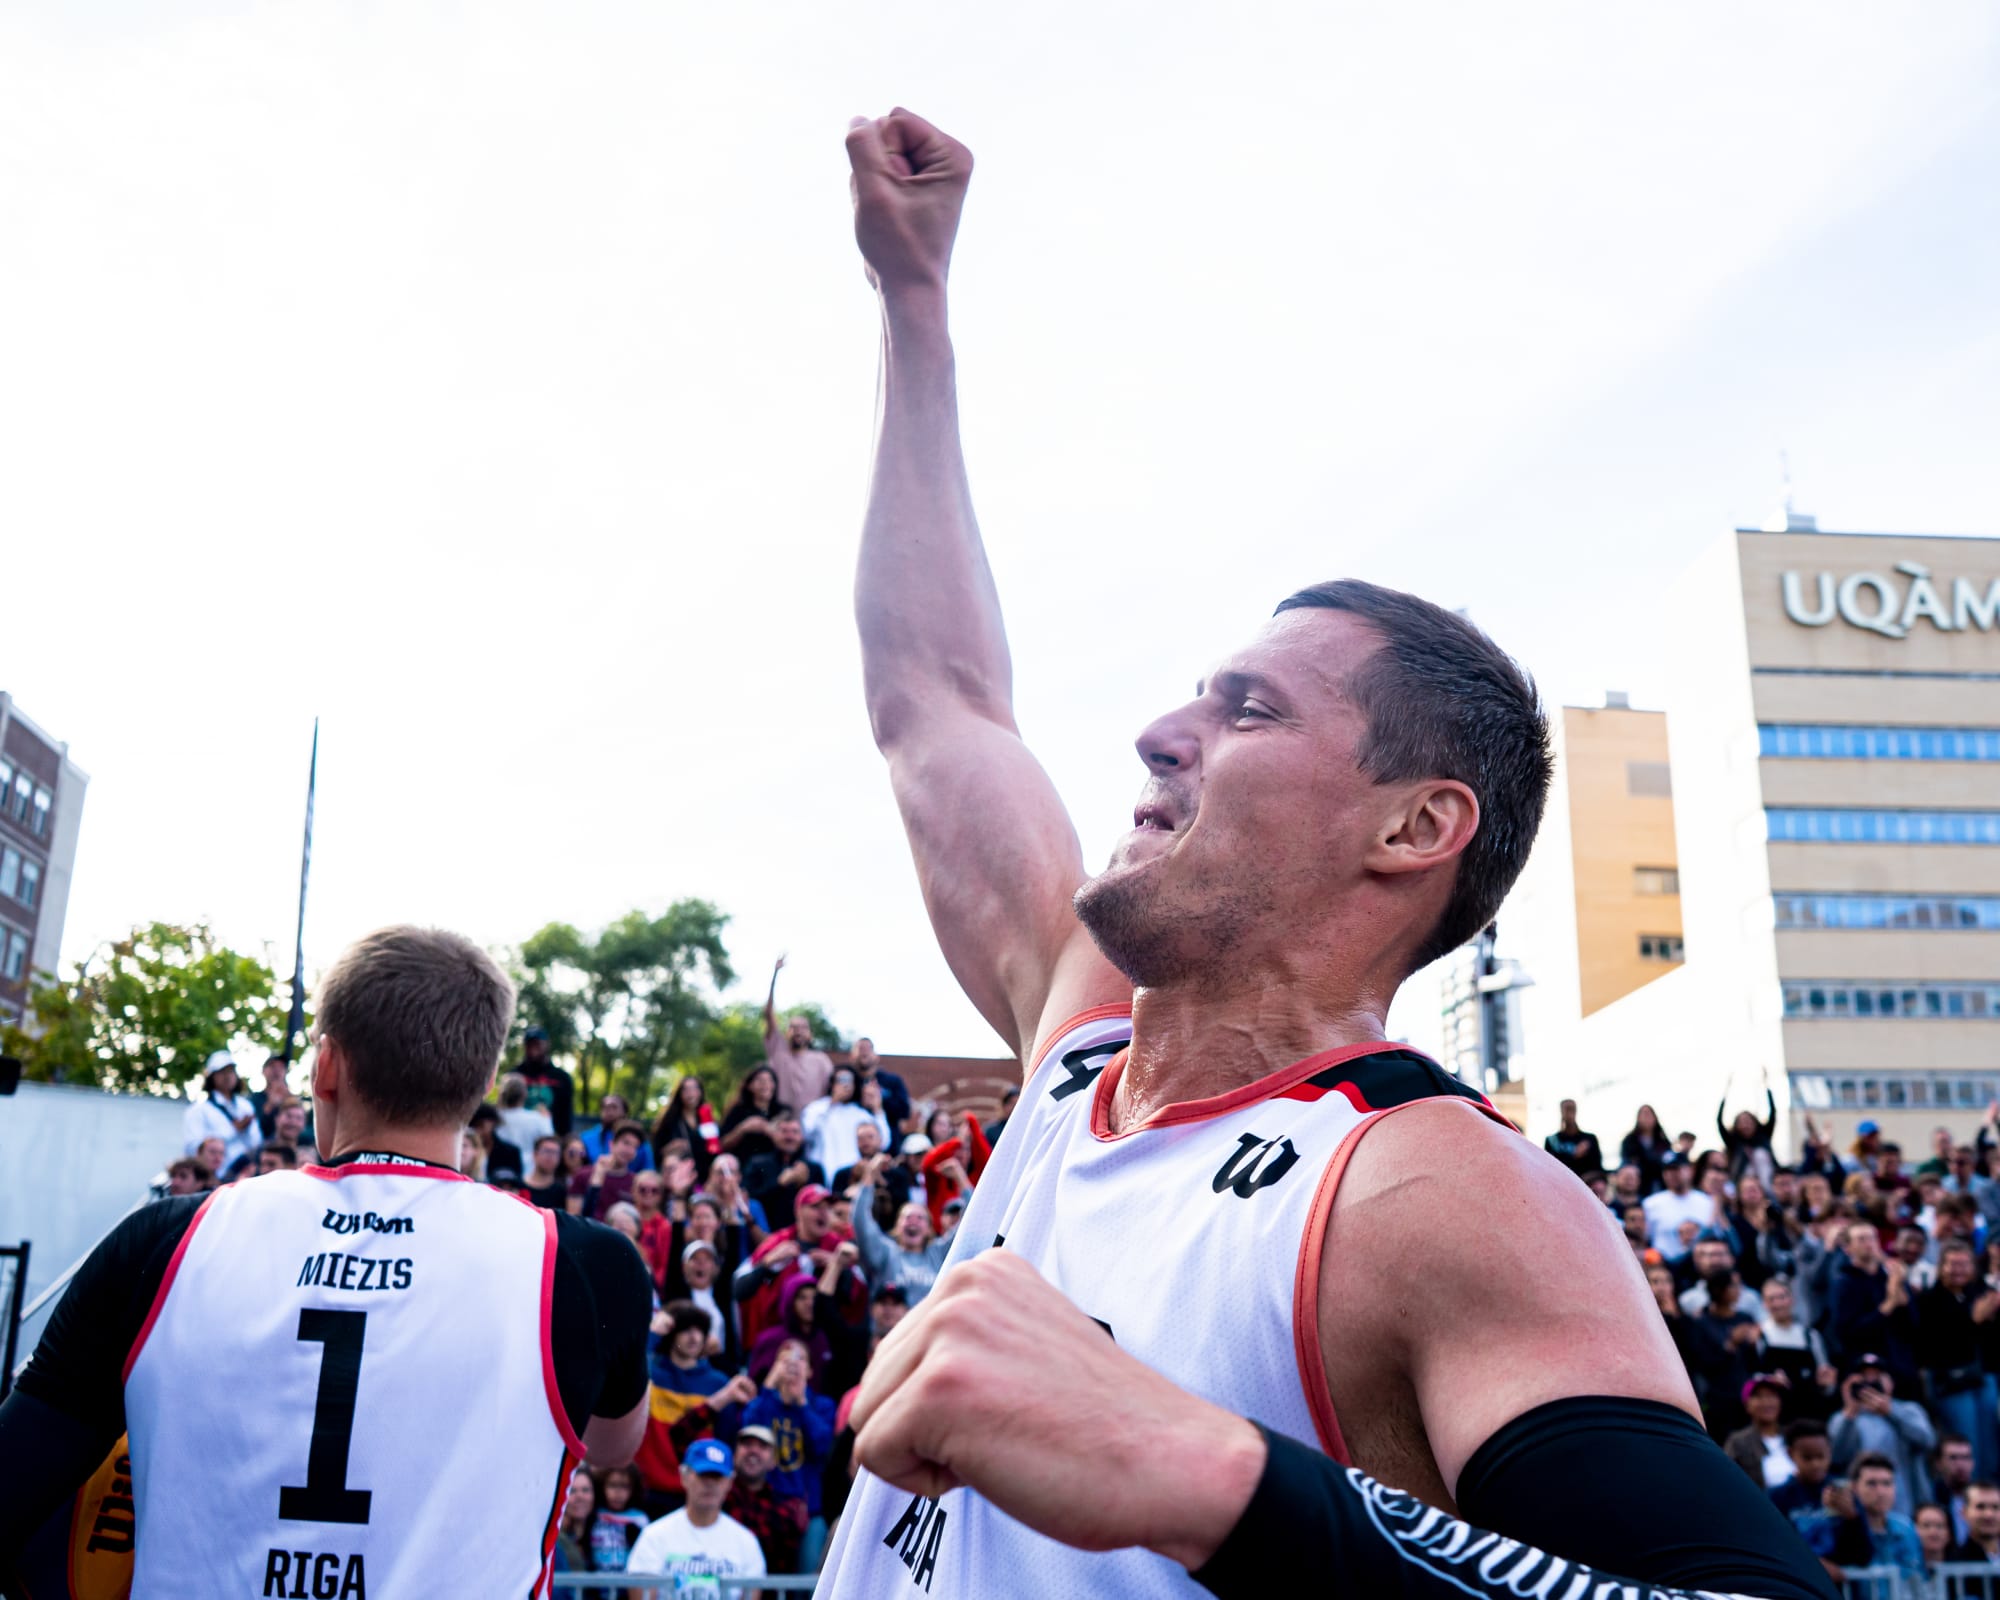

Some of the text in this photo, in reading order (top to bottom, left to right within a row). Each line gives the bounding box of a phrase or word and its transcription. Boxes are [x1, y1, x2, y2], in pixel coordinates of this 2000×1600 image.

[296, 1252, 414, 1291] MIEZIS
[278, 1307, 373, 1525] 1
[262, 1548, 367, 1600] RIGA
[882, 1494, 948, 1595] RIA
